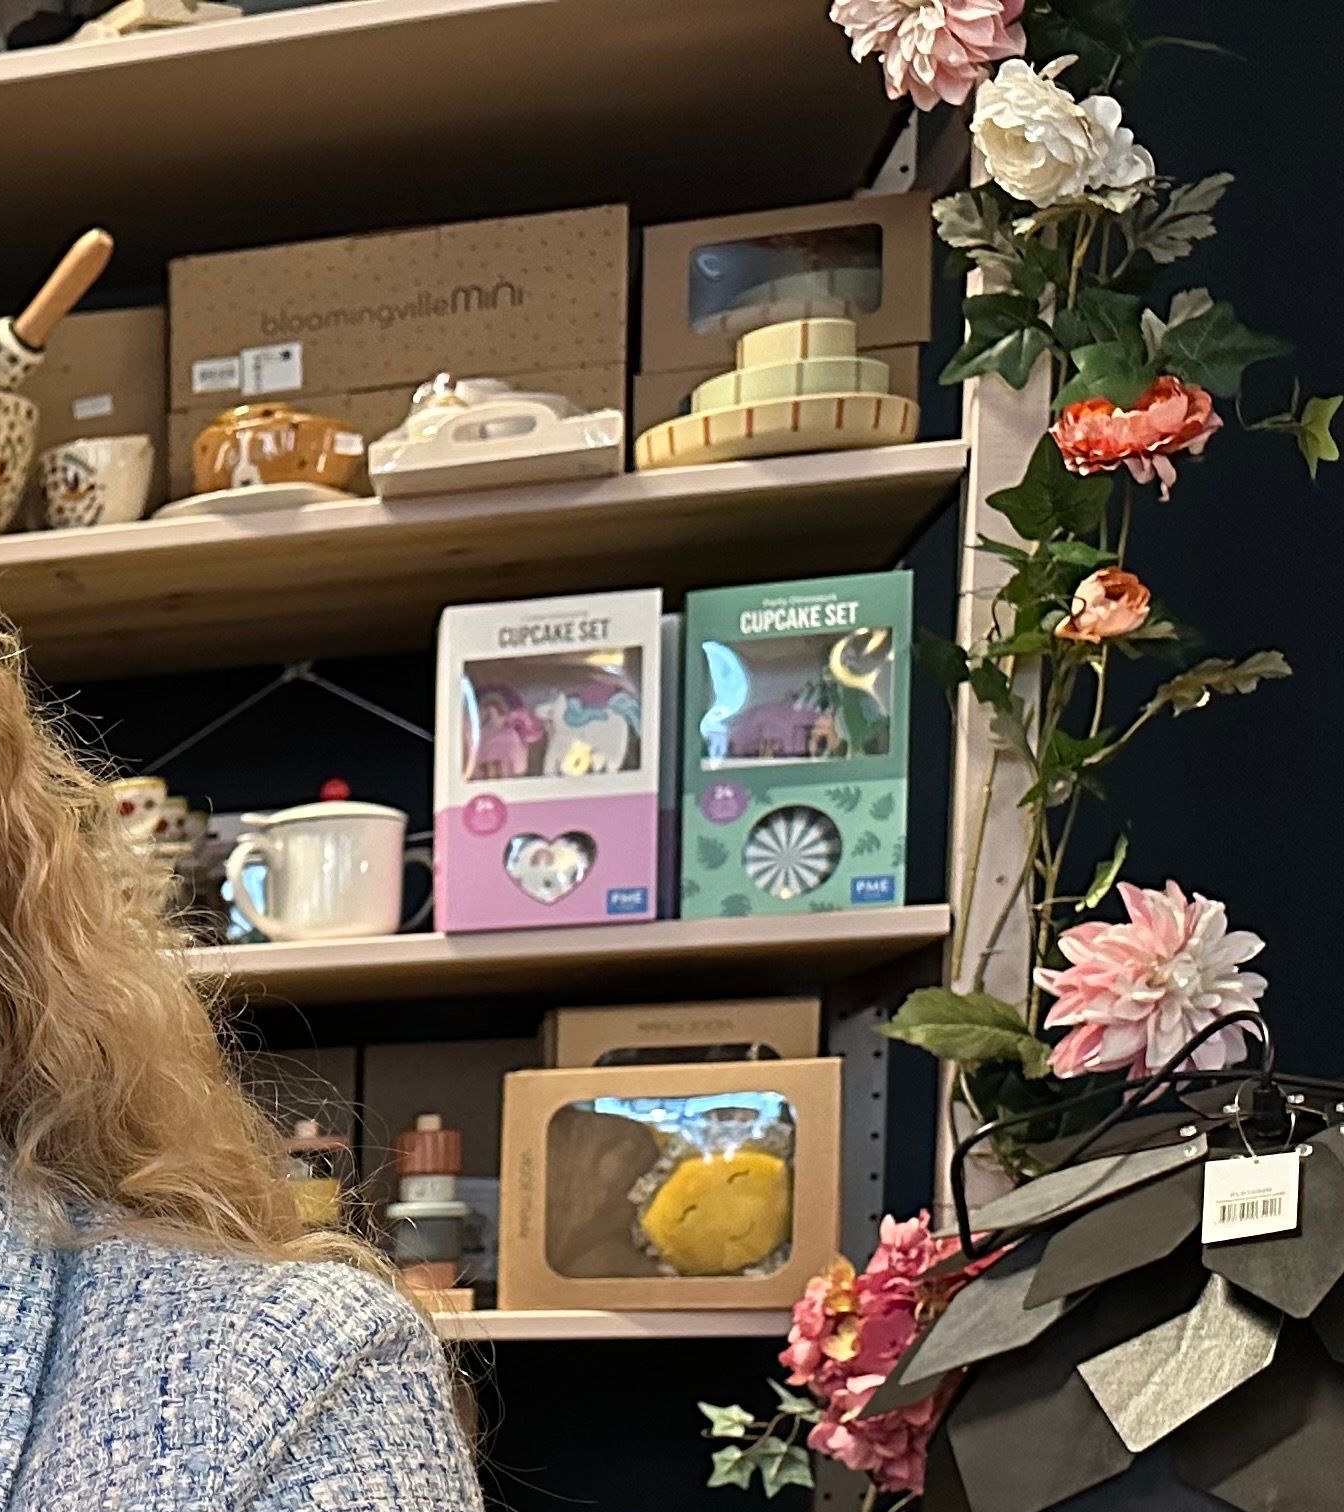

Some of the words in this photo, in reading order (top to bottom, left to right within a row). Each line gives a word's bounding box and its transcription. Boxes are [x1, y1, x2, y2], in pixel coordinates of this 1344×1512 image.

[740, 608, 822, 635] CUPCAKE
[825, 601, 860, 627] SET
[498, 622, 576, 650] CUPCAKE
[578, 619, 611, 643] SET
